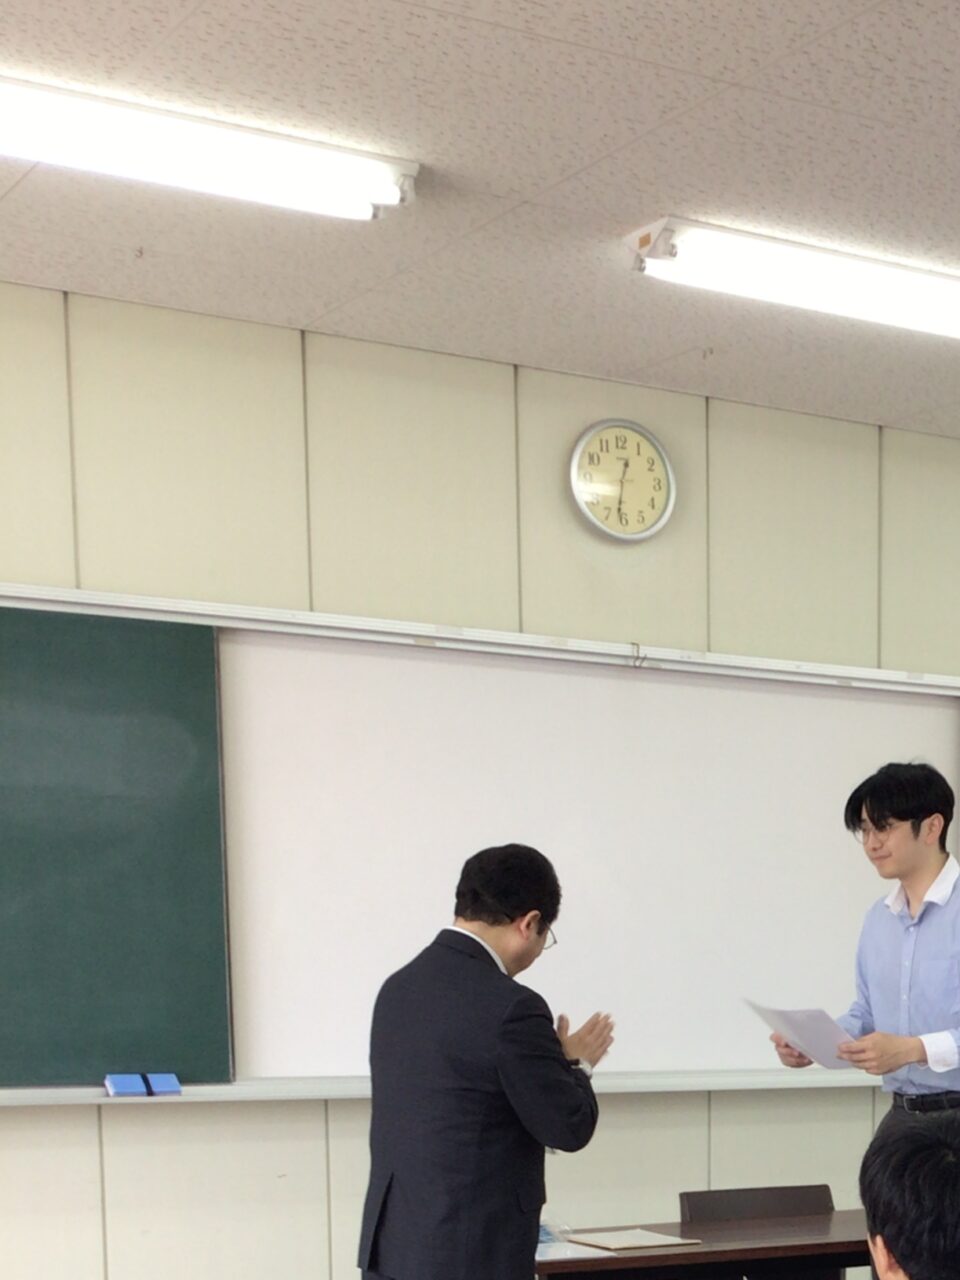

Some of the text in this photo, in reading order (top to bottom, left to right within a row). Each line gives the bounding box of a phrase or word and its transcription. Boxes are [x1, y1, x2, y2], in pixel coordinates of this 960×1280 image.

[599, 438, 610, 453] 11
[615, 434, 627, 450] 12
[588, 451, 601, 466] 10
[647, 457, 656, 472] 2
[652, 477, 662, 492] 3
[648, 496, 656, 511] 4
[603, 506, 612, 521] 7
[619, 511, 629, 527] 6
[637, 510, 645, 524] 5
